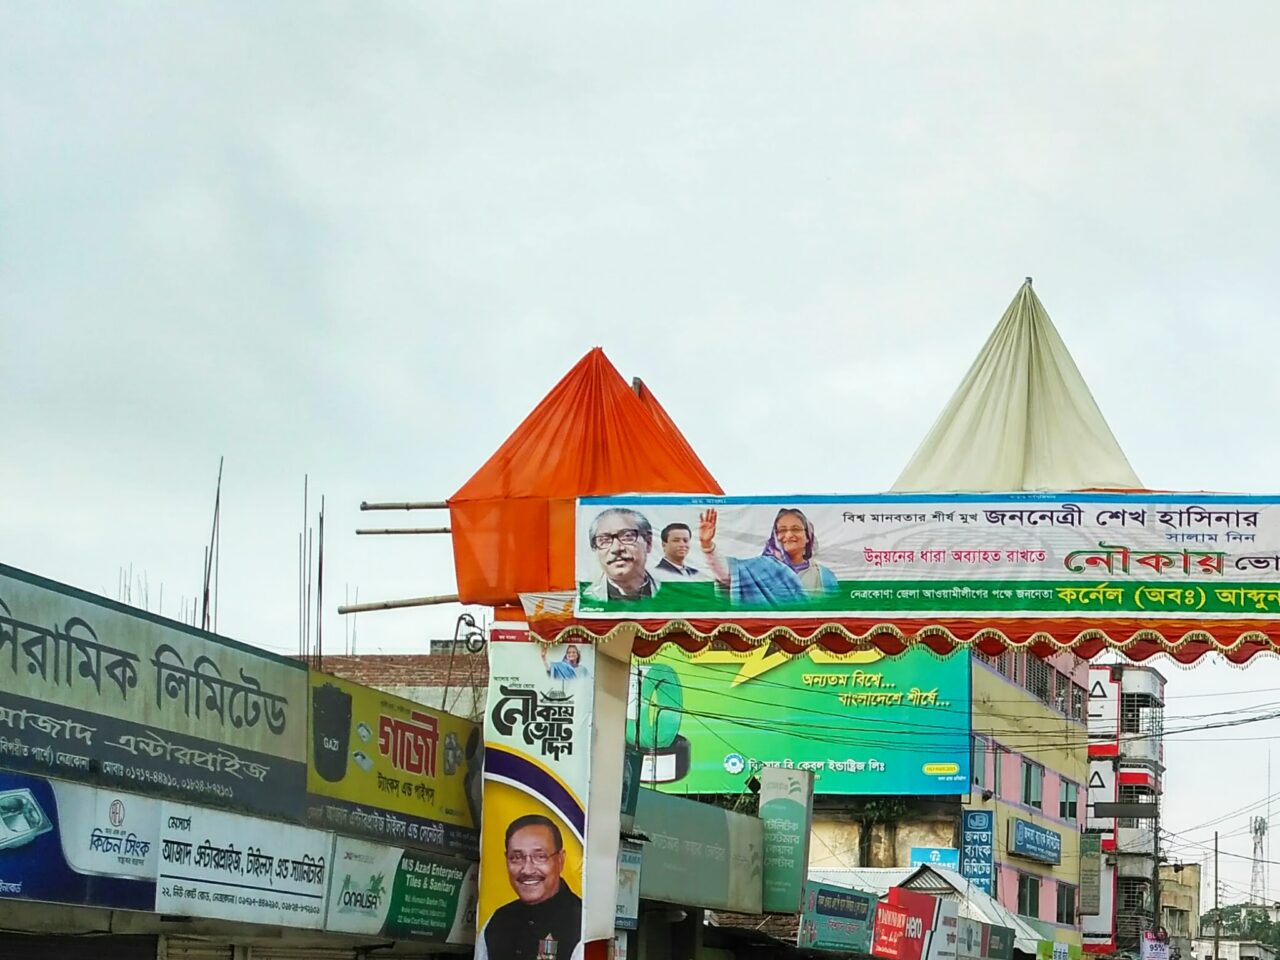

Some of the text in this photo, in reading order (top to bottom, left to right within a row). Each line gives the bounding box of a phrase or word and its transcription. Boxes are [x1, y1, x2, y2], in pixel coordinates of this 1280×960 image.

[843, 511, 865, 523] বিশ্ব
[870, 512, 926, 523] মানবতার
[959, 512, 978, 524] মুখ
[982, 503, 1084, 527] জননেত্রী
[1096, 508, 1148, 527] শেখ
[1156, 506, 1259, 530] হাসিনার
[1165, 531, 1256, 543] সালাম নিন
[863, 547, 915, 567] উন্নয়নের
[920, 549, 947, 563] ধারা
[951, 549, 1002, 564] অব্যাহত
[1006, 549, 1046, 563] রাখতে
[1064, 541, 1227, 576] নৌকায়
[896, 589, 920, 599] জেলা
[923, 586, 988, 599] আওয়ামীলীগের
[992, 589, 1013, 599] পক্ষে
[1016, 589, 1053, 600] জননেতা
[1056, 582, 1124, 605] কর্নেল
[1134, 585, 1206, 610] (অবঃ)
[150, 644, 288, 735] লিমিটেড
[802, 673, 849, 687] অন্যতম
[492, 684, 574, 736] নৌকায়
[838, 692, 903, 707] বাংলাদেশে
[523, 718, 573, 745] ভোট
[104, 730, 271, 782] এন্টারপ্রাইজ
[378, 711, 439, 779] গাজী
[541, 737, 573, 761] দিন
[868, 759, 885, 771] লিঃ
[168, 815, 191, 832] মেসার্স
[89, 828, 151, 857] কিচেন সিংক
[964, 830, 992, 845] জনতা
[162, 839, 192, 866] আজাদ
[964, 844, 991, 858] ব্যাংক
[414, 860, 431, 874] Azad
[432, 864, 464, 880] Enterprise
[406, 874, 456, 896] Tiles & Sanitary
